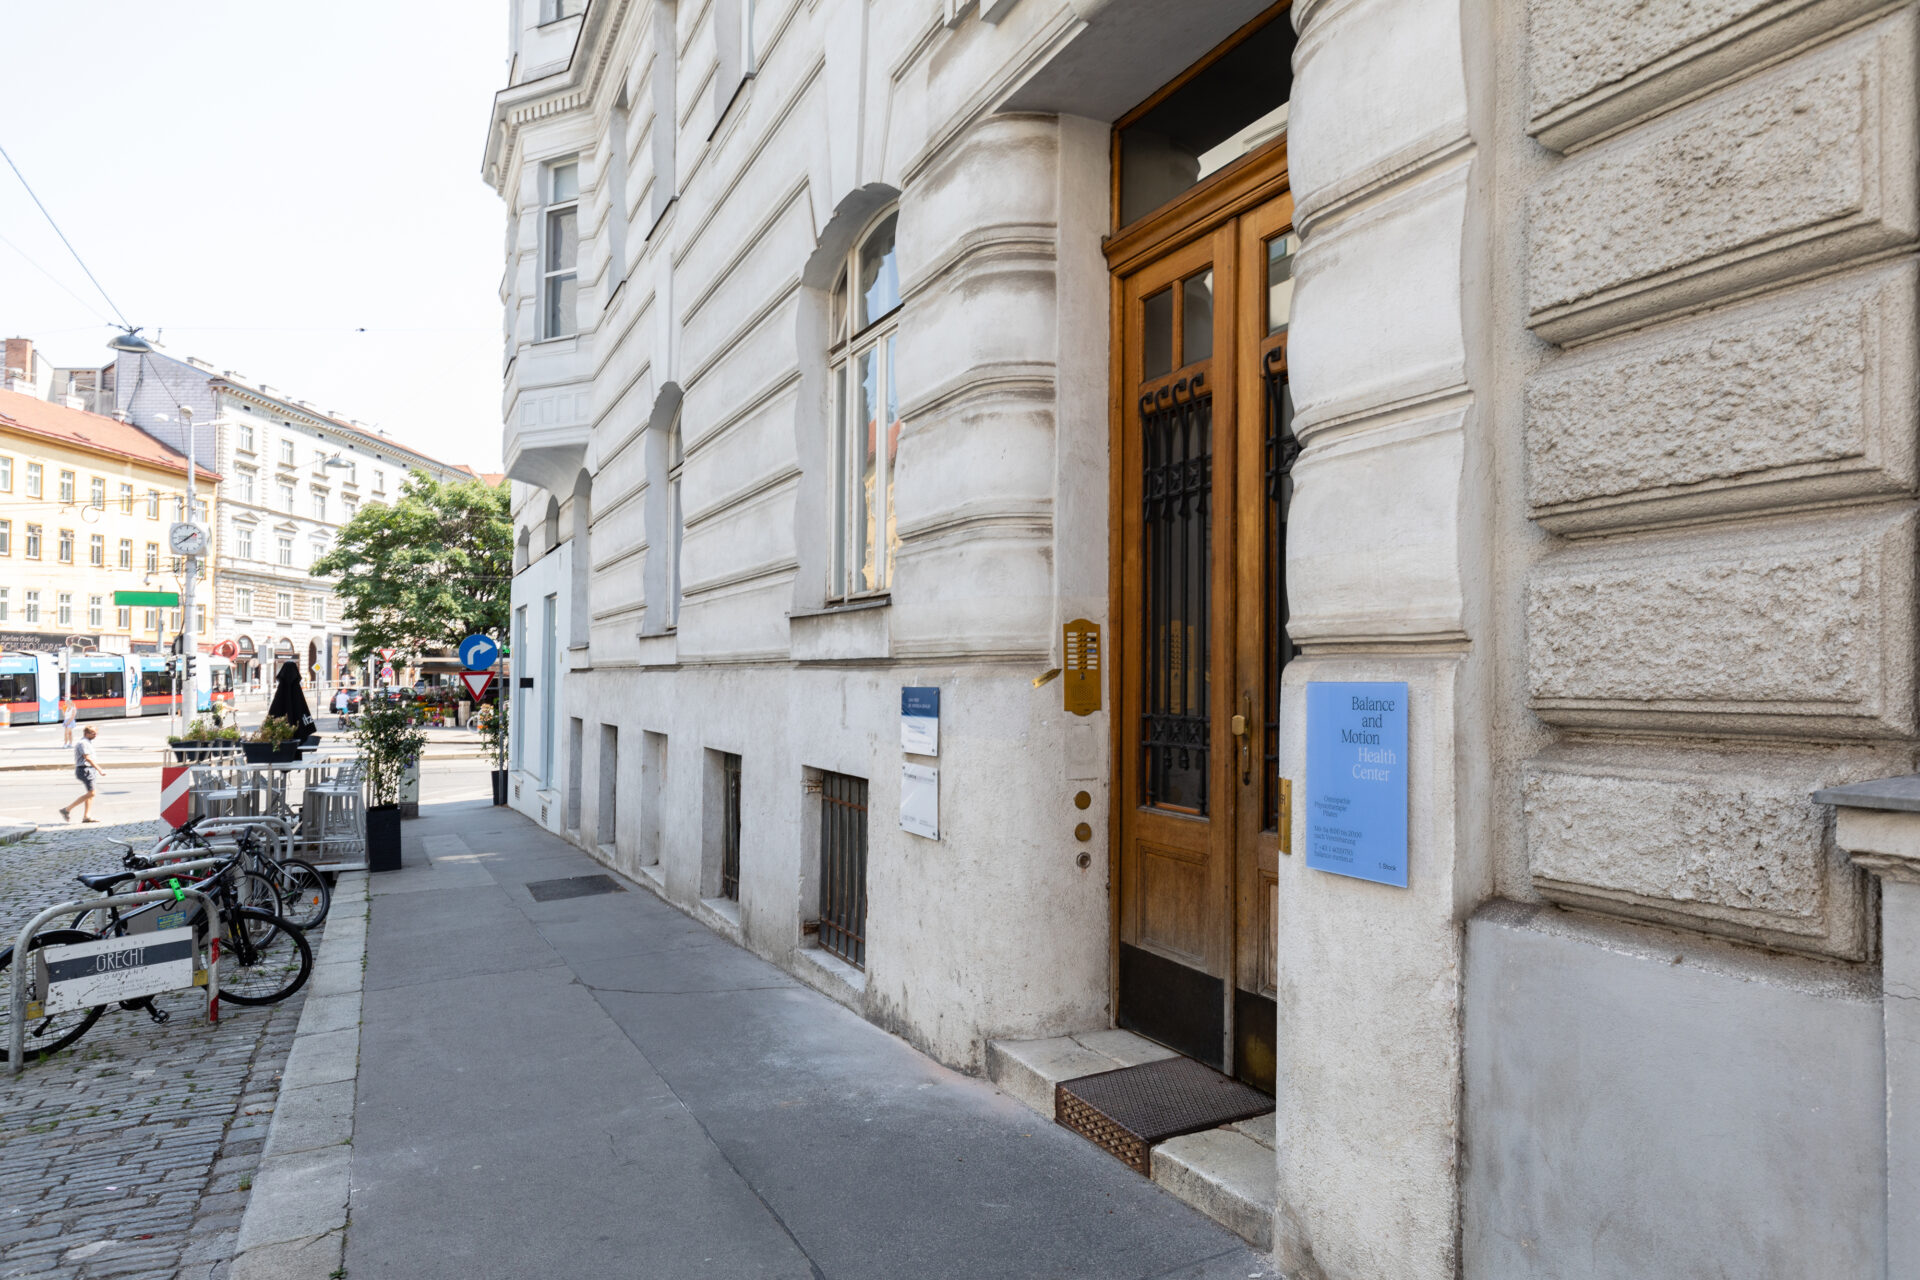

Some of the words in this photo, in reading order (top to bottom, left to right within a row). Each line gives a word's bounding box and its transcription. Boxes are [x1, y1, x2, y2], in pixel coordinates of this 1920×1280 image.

[1352, 696, 1395, 711] Balance
[1361, 714, 1383, 728] and
[1341, 729, 1380, 745] Motion
[1358, 747, 1397, 764] Health
[1352, 764, 1391, 782] Center
[96, 947, 146, 972] GRECHT
